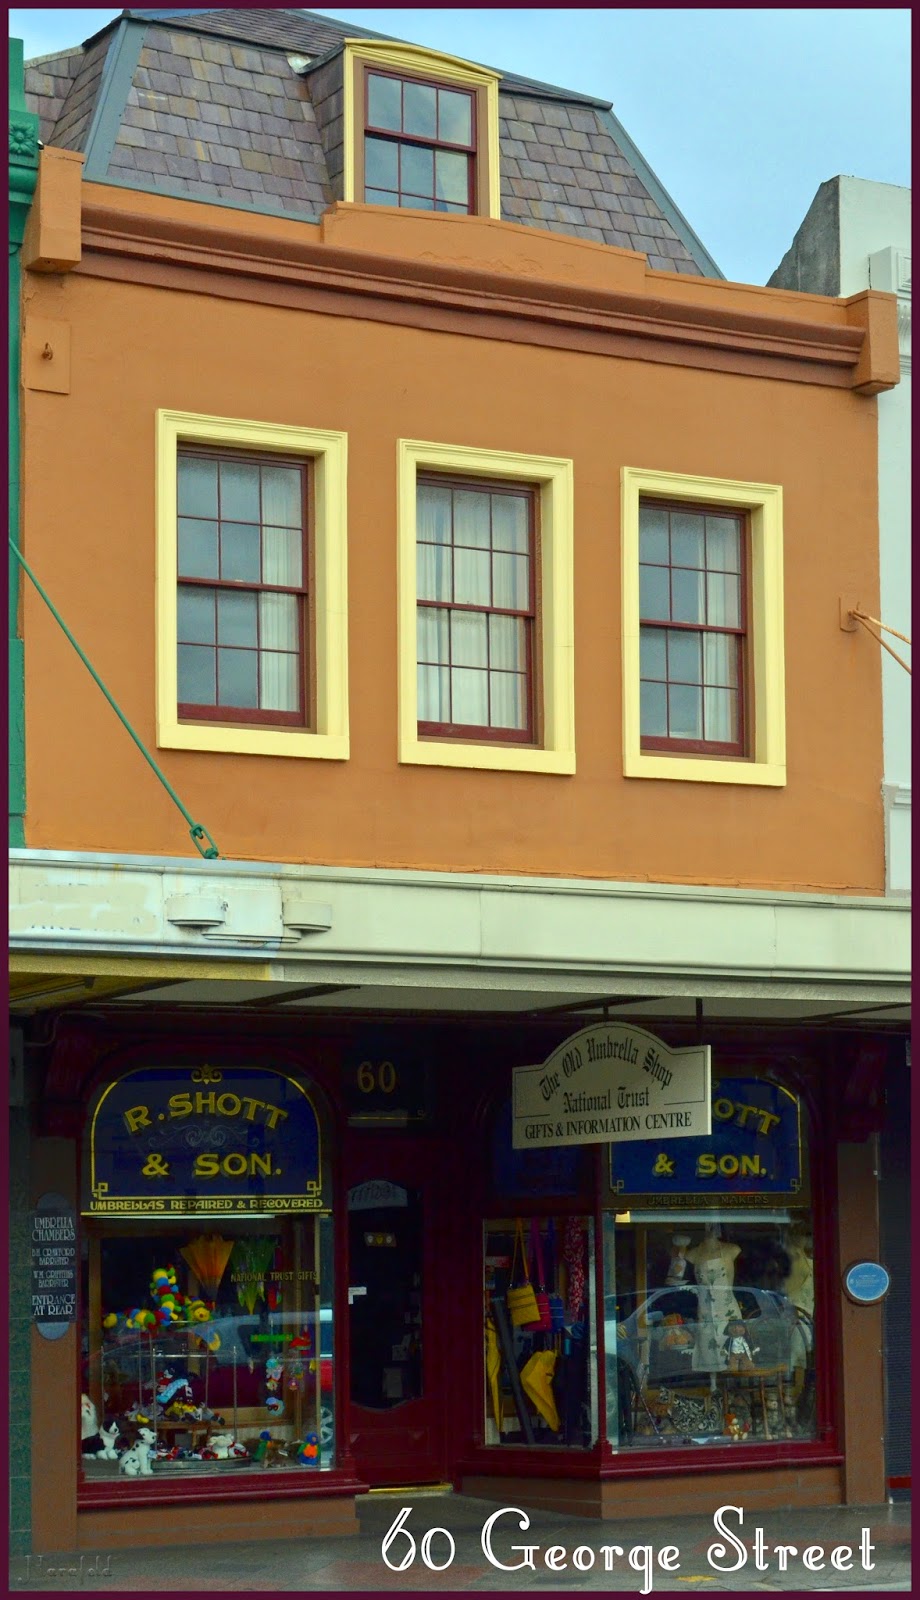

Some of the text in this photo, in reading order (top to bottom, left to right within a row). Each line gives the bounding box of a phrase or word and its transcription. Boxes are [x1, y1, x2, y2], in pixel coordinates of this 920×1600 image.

[357, 1061, 396, 1094] 60
[540, 1036, 673, 1101] The Old Umbrella Shop
[563, 1086, 649, 1114] National Trust
[525, 1111, 693, 1140] GIFTS & INFORMATION CENTRE
[713, 1098, 781, 1135] OTT
[141, 1153, 282, 1177] & SON.
[653, 1153, 768, 1177] & SON.
[90, 1199, 323, 1211] UMBRELLAS REPAIRED & RECOVERED
[32, 1229, 75, 1242] CHAMBERS
[34, 1217, 73, 1230] UMBRELLA
[231, 1271, 317, 1282] NATIONAL TRUST GIFTS
[32, 1294, 75, 1306] ENTRANCE
[34, 1305, 74, 1316] AT REAR
